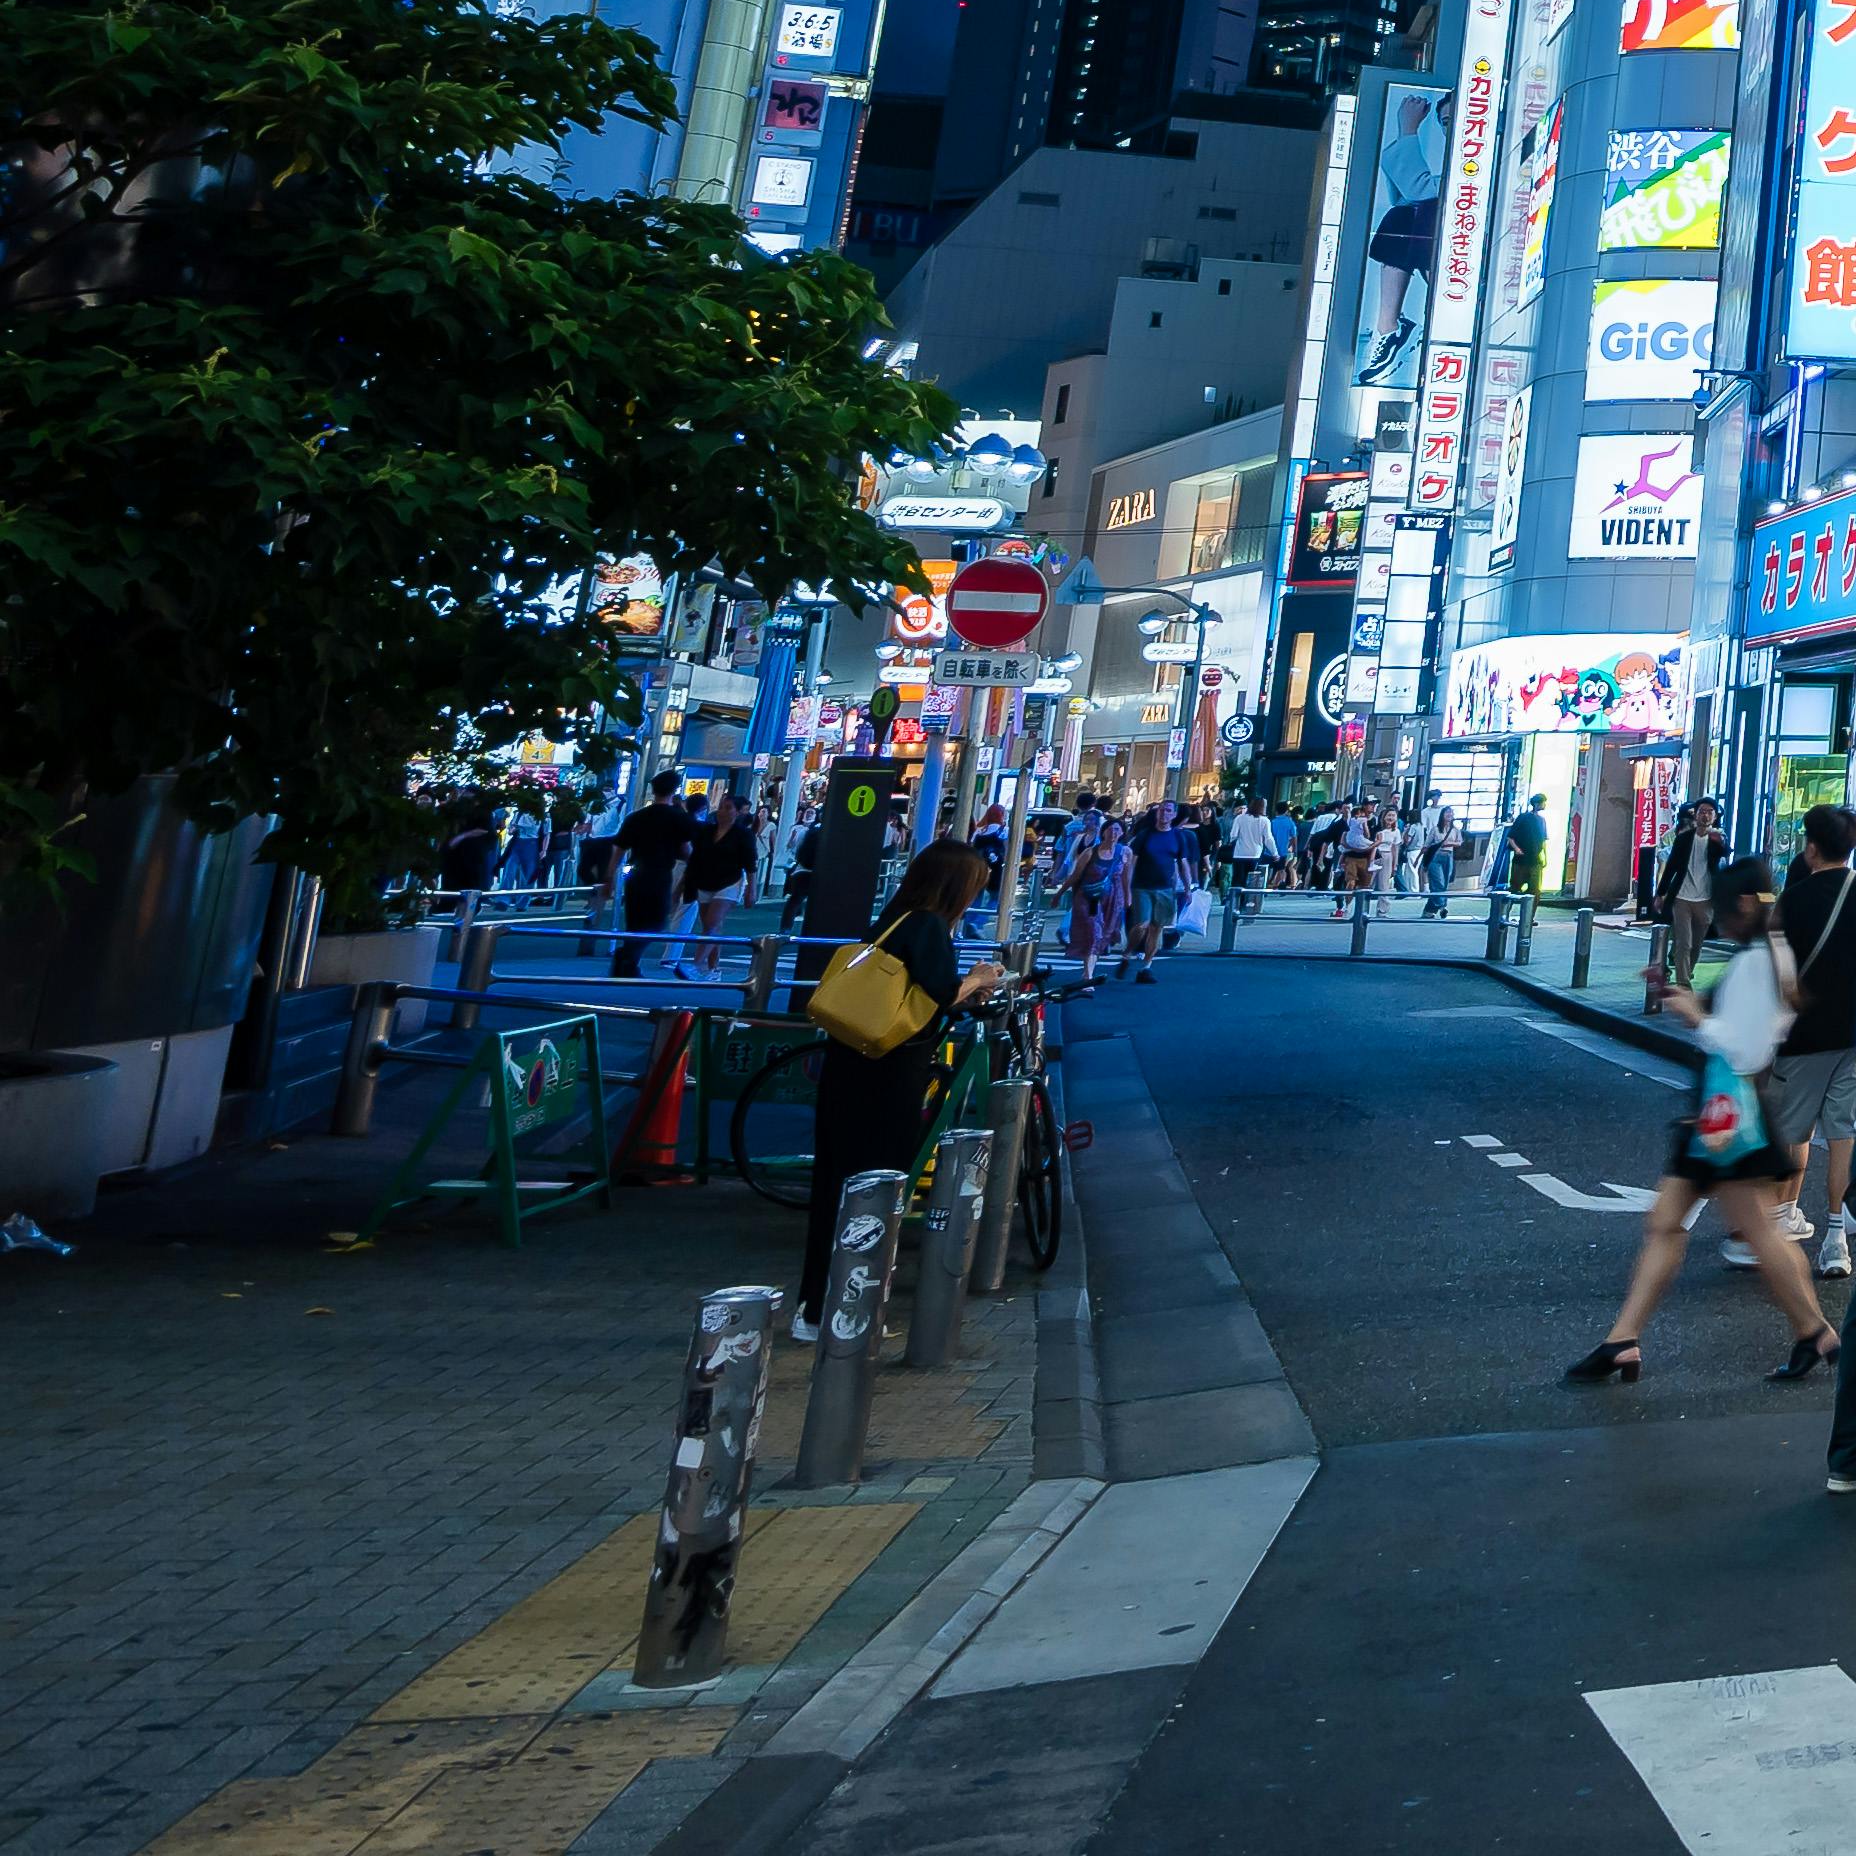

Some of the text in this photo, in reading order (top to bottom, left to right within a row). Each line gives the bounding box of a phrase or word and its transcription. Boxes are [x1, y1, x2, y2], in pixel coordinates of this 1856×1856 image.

[791, 31, 824, 48] 酒場
[1458, 75, 1492, 162] カラオケ
[1606, 132, 1685, 174] 渋谷
[1444, 183, 1480, 302] まねきねこ
[1416, 348, 1472, 507] カラオケ
[891, 504, 998, 520] 渋谷センター街
[1106, 488, 1157, 531] ZARA
[1627, 506, 1664, 515] SHIBUYA
[1600, 519, 1692, 546] VIDENT
[941, 659, 1029, 680] 自転車を除く
[1140, 704, 1169, 723] ZARA
[1307, 760, 1323, 771] THE
